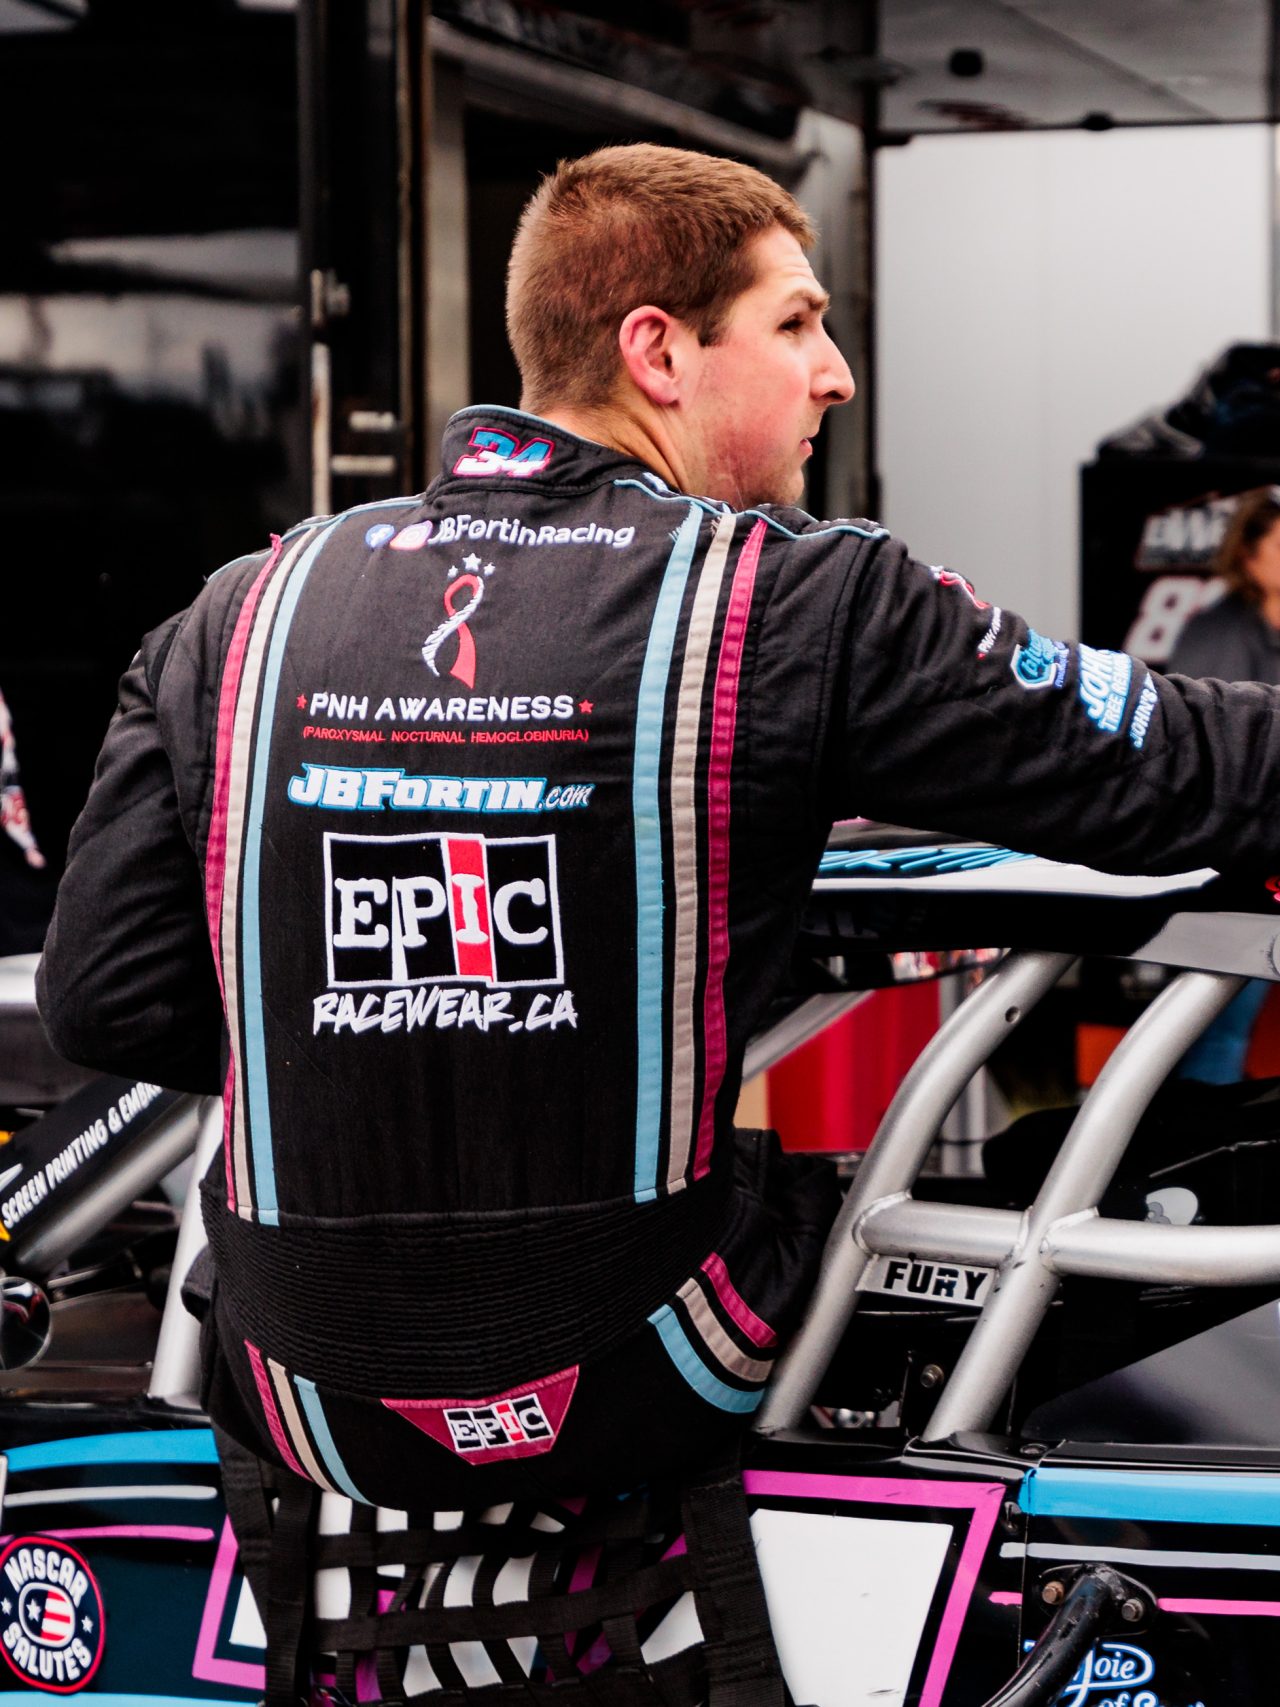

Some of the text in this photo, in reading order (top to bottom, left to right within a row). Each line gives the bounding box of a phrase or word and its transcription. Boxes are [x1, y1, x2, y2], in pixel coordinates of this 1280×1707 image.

[453, 427, 556, 478] 34
[310, 692, 574, 722] PNH AWARENESS
[302, 726, 589, 745] (PAROXYSMAL NOCTURNAL HEMOGLOBINURIA)
[333, 873, 549, 949] EPIC
[313, 986, 579, 1036] RACEWEAR.CA
[1, 1171, 49, 1229] SCREEN
[45, 1118, 108, 1190] PRINTING
[107, 1106, 124, 1134] &
[883, 1261, 988, 1301] FURY
[447, 1403, 549, 1443] EPIC
[3, 1547, 90, 1608] NASCAR
[2, 1621, 92, 1682] SALUTES
